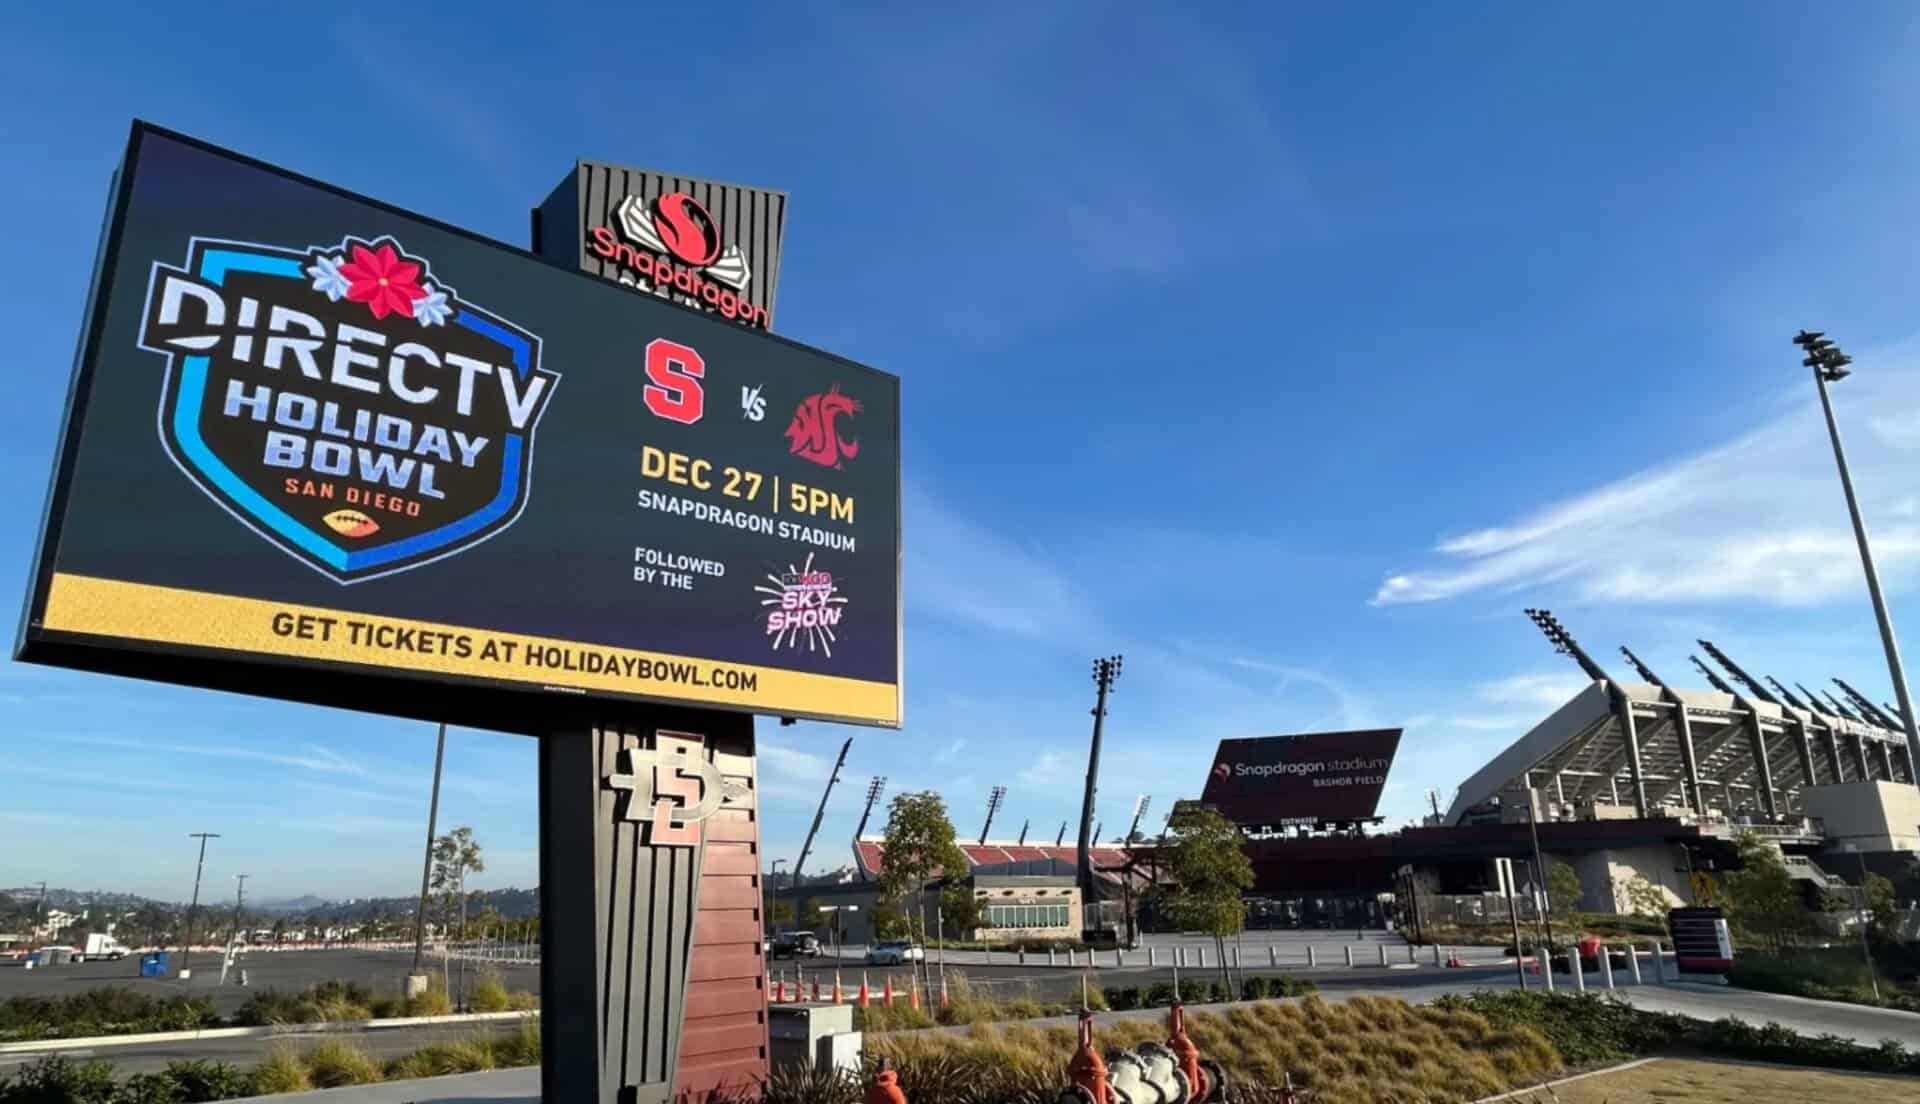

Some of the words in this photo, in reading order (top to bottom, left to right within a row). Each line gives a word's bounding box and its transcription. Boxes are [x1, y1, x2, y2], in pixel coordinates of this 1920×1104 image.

[591, 226, 769, 329] Snapdragon
[158, 276, 546, 429] DIRECTV
[643, 337, 705, 424] S
[741, 383, 767, 422] VS
[223, 378, 489, 468] HOLIDAY
[263, 431, 446, 500] BOWL
[641, 445, 712, 490] DEC
[722, 466, 763, 501] 27
[790, 483, 855, 524] 5PM
[284, 477, 334, 501] SAN
[346, 487, 421, 517] DIEGO
[637, 489, 774, 535] SNAPDRAGON
[778, 521, 856, 553] STADIUM
[633, 566, 657, 584] BY
[660, 570, 694, 591] THE
[634, 546, 726, 578] FOLLOWED
[767, 607, 842, 632] SHOW
[782, 591, 831, 610] SKY
[271, 612, 338, 642] GET
[346, 620, 473, 659] TICKETS
[479, 638, 518, 663] AT
[525, 643, 758, 692] HOLIDAYBOWL.COM
[1235, 760, 1325, 778] Snapdragon
[1327, 756, 1390, 772] stadium
[1354, 775, 1385, 785] FIELD
